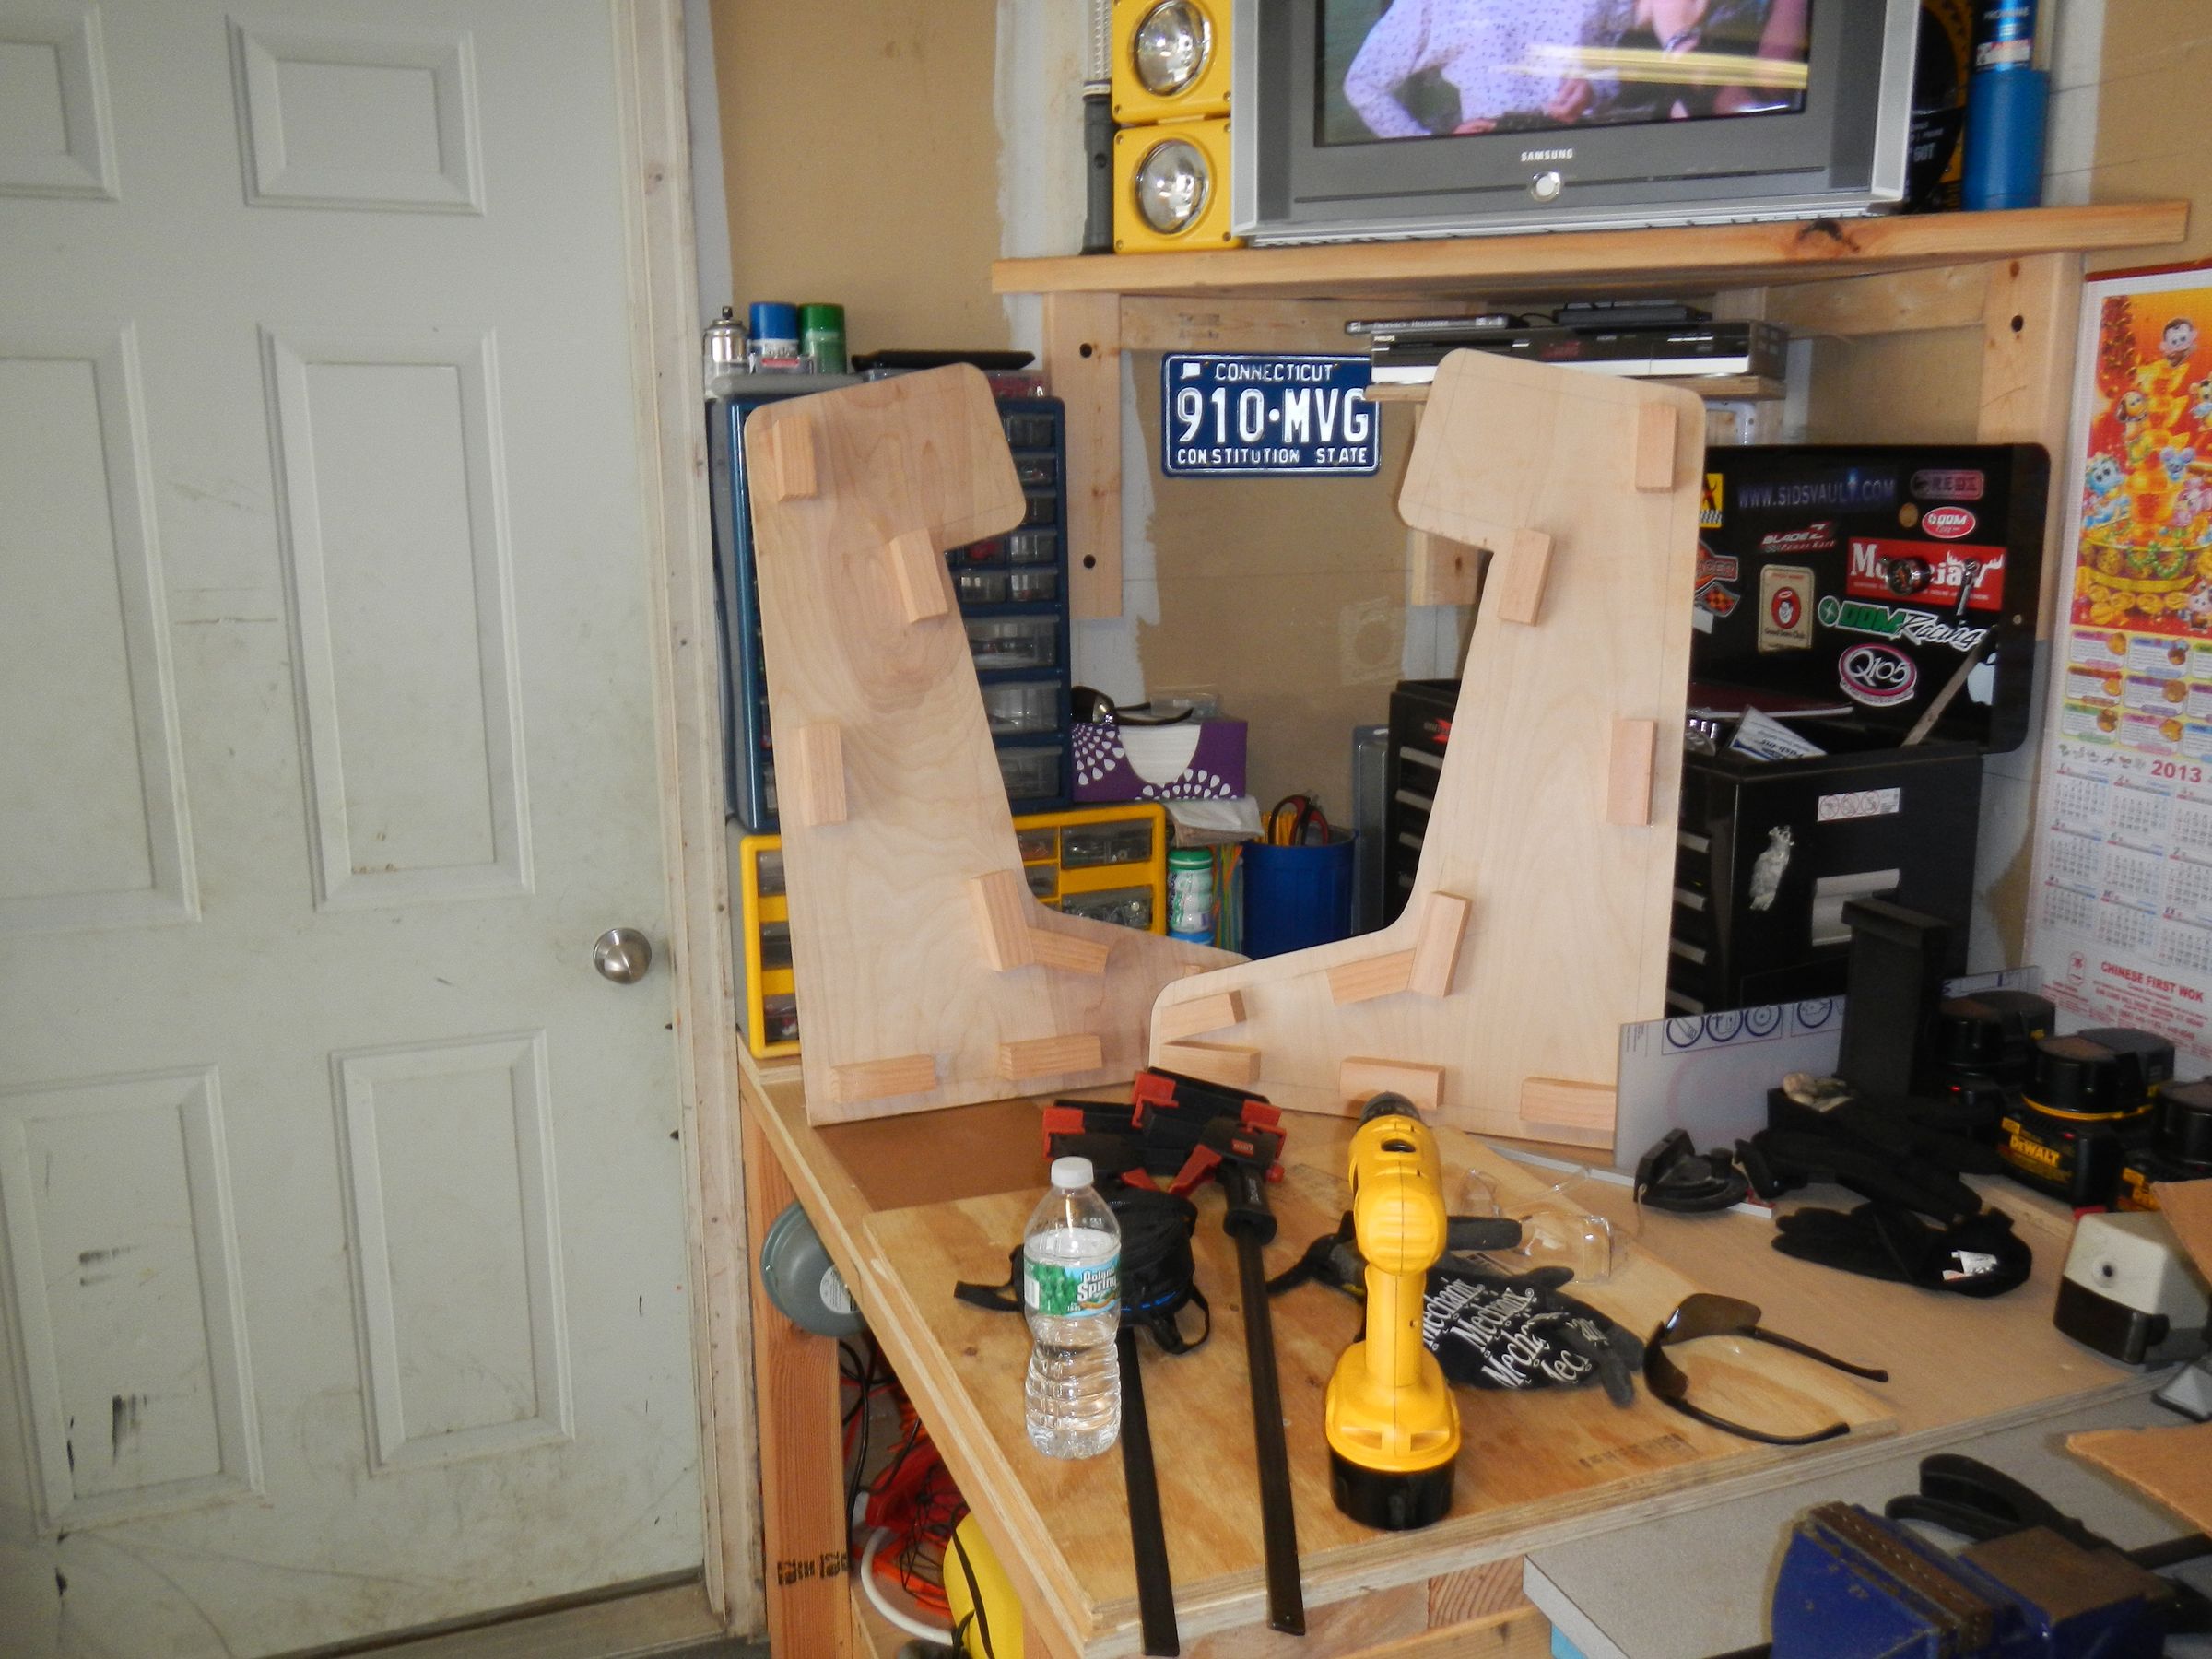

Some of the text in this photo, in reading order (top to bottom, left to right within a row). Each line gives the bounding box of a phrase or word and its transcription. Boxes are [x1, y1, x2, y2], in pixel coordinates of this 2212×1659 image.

[1521, 148, 1573, 162] SAMSUNG
[1214, 363, 1333, 382] CONNECTICUT
[1177, 447, 1368, 464] CONSTITUTION STATE
[1900, 612, 1987, 647] Racing
[1847, 649, 1911, 687] Q105
[2150, 759, 2202, 783] 2013
[2100, 961, 2144, 984] CHINESE
[2146, 975, 2176, 994] FIRST
[2178, 985, 2204, 1003] WOK
[1082, 1266, 1115, 1284] Poland
[1077, 1276, 1117, 1301] Spring
